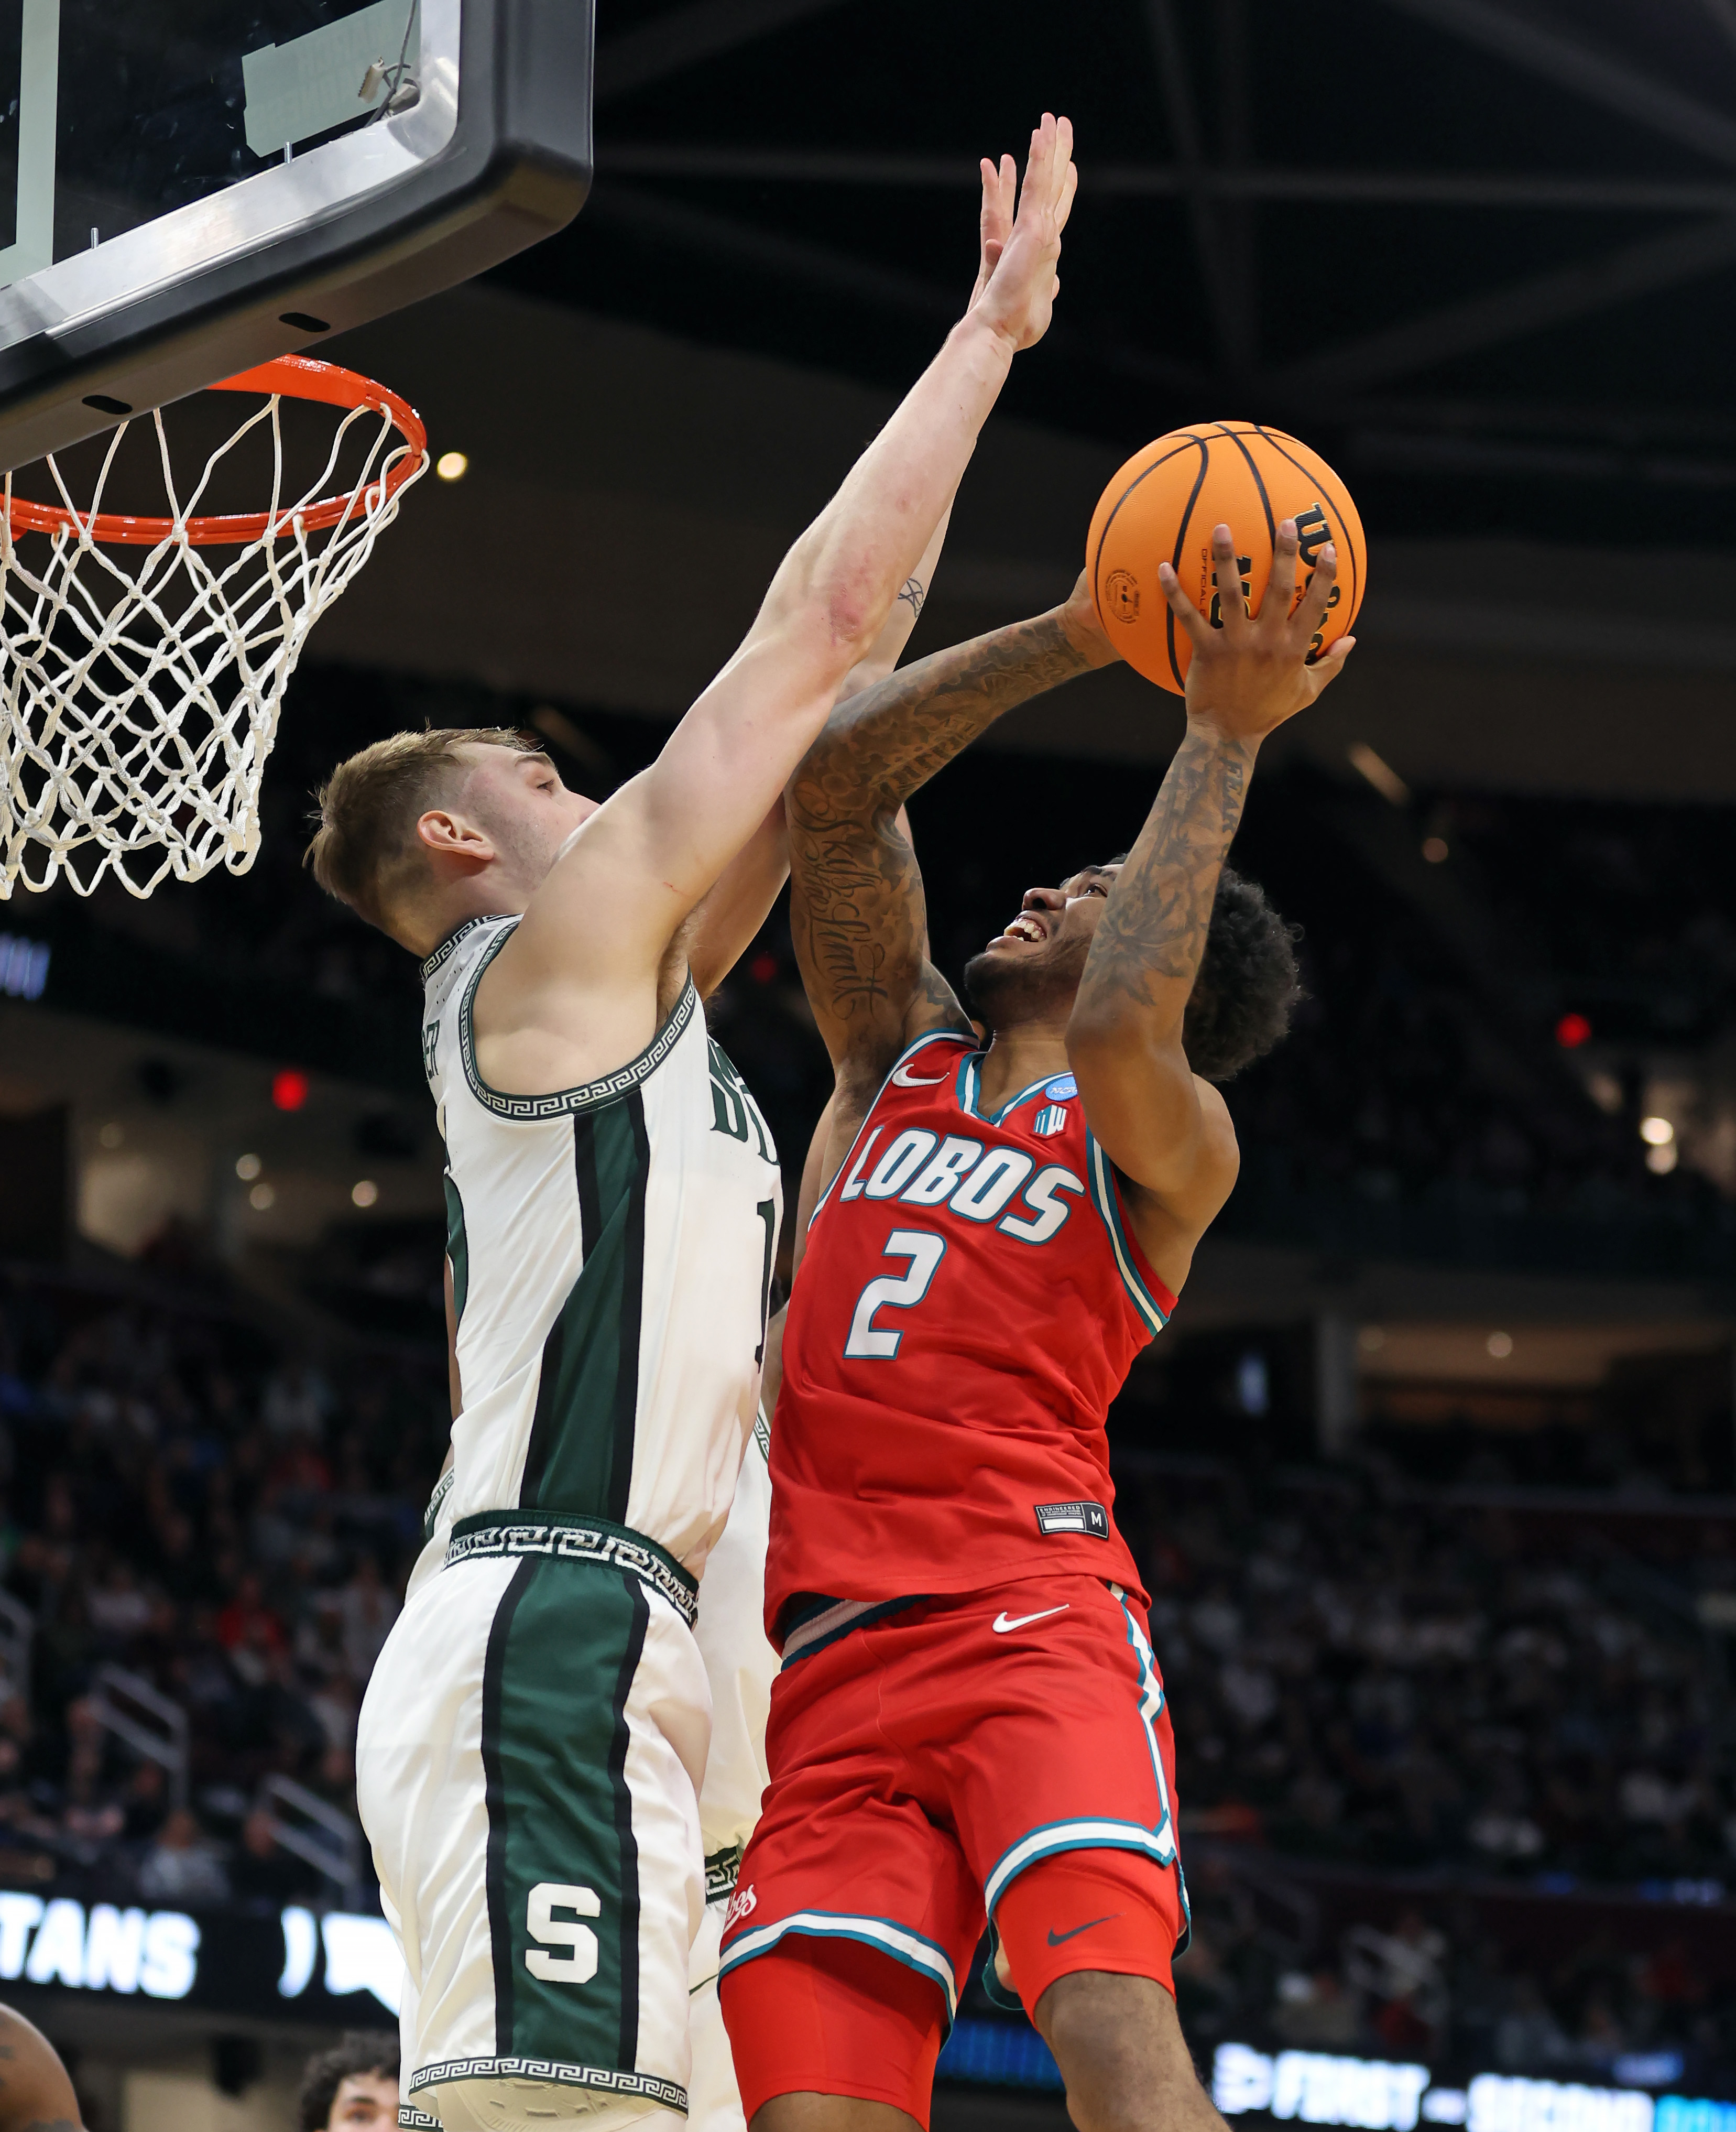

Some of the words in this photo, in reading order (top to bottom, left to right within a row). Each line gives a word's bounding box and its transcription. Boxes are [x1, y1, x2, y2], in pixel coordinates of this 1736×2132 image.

[839, 1125, 1085, 1246] LOBOS
[843, 1228, 947, 1361] 2
[1090, 1511, 1102, 1527] M
[525, 1882, 601, 1984] S
